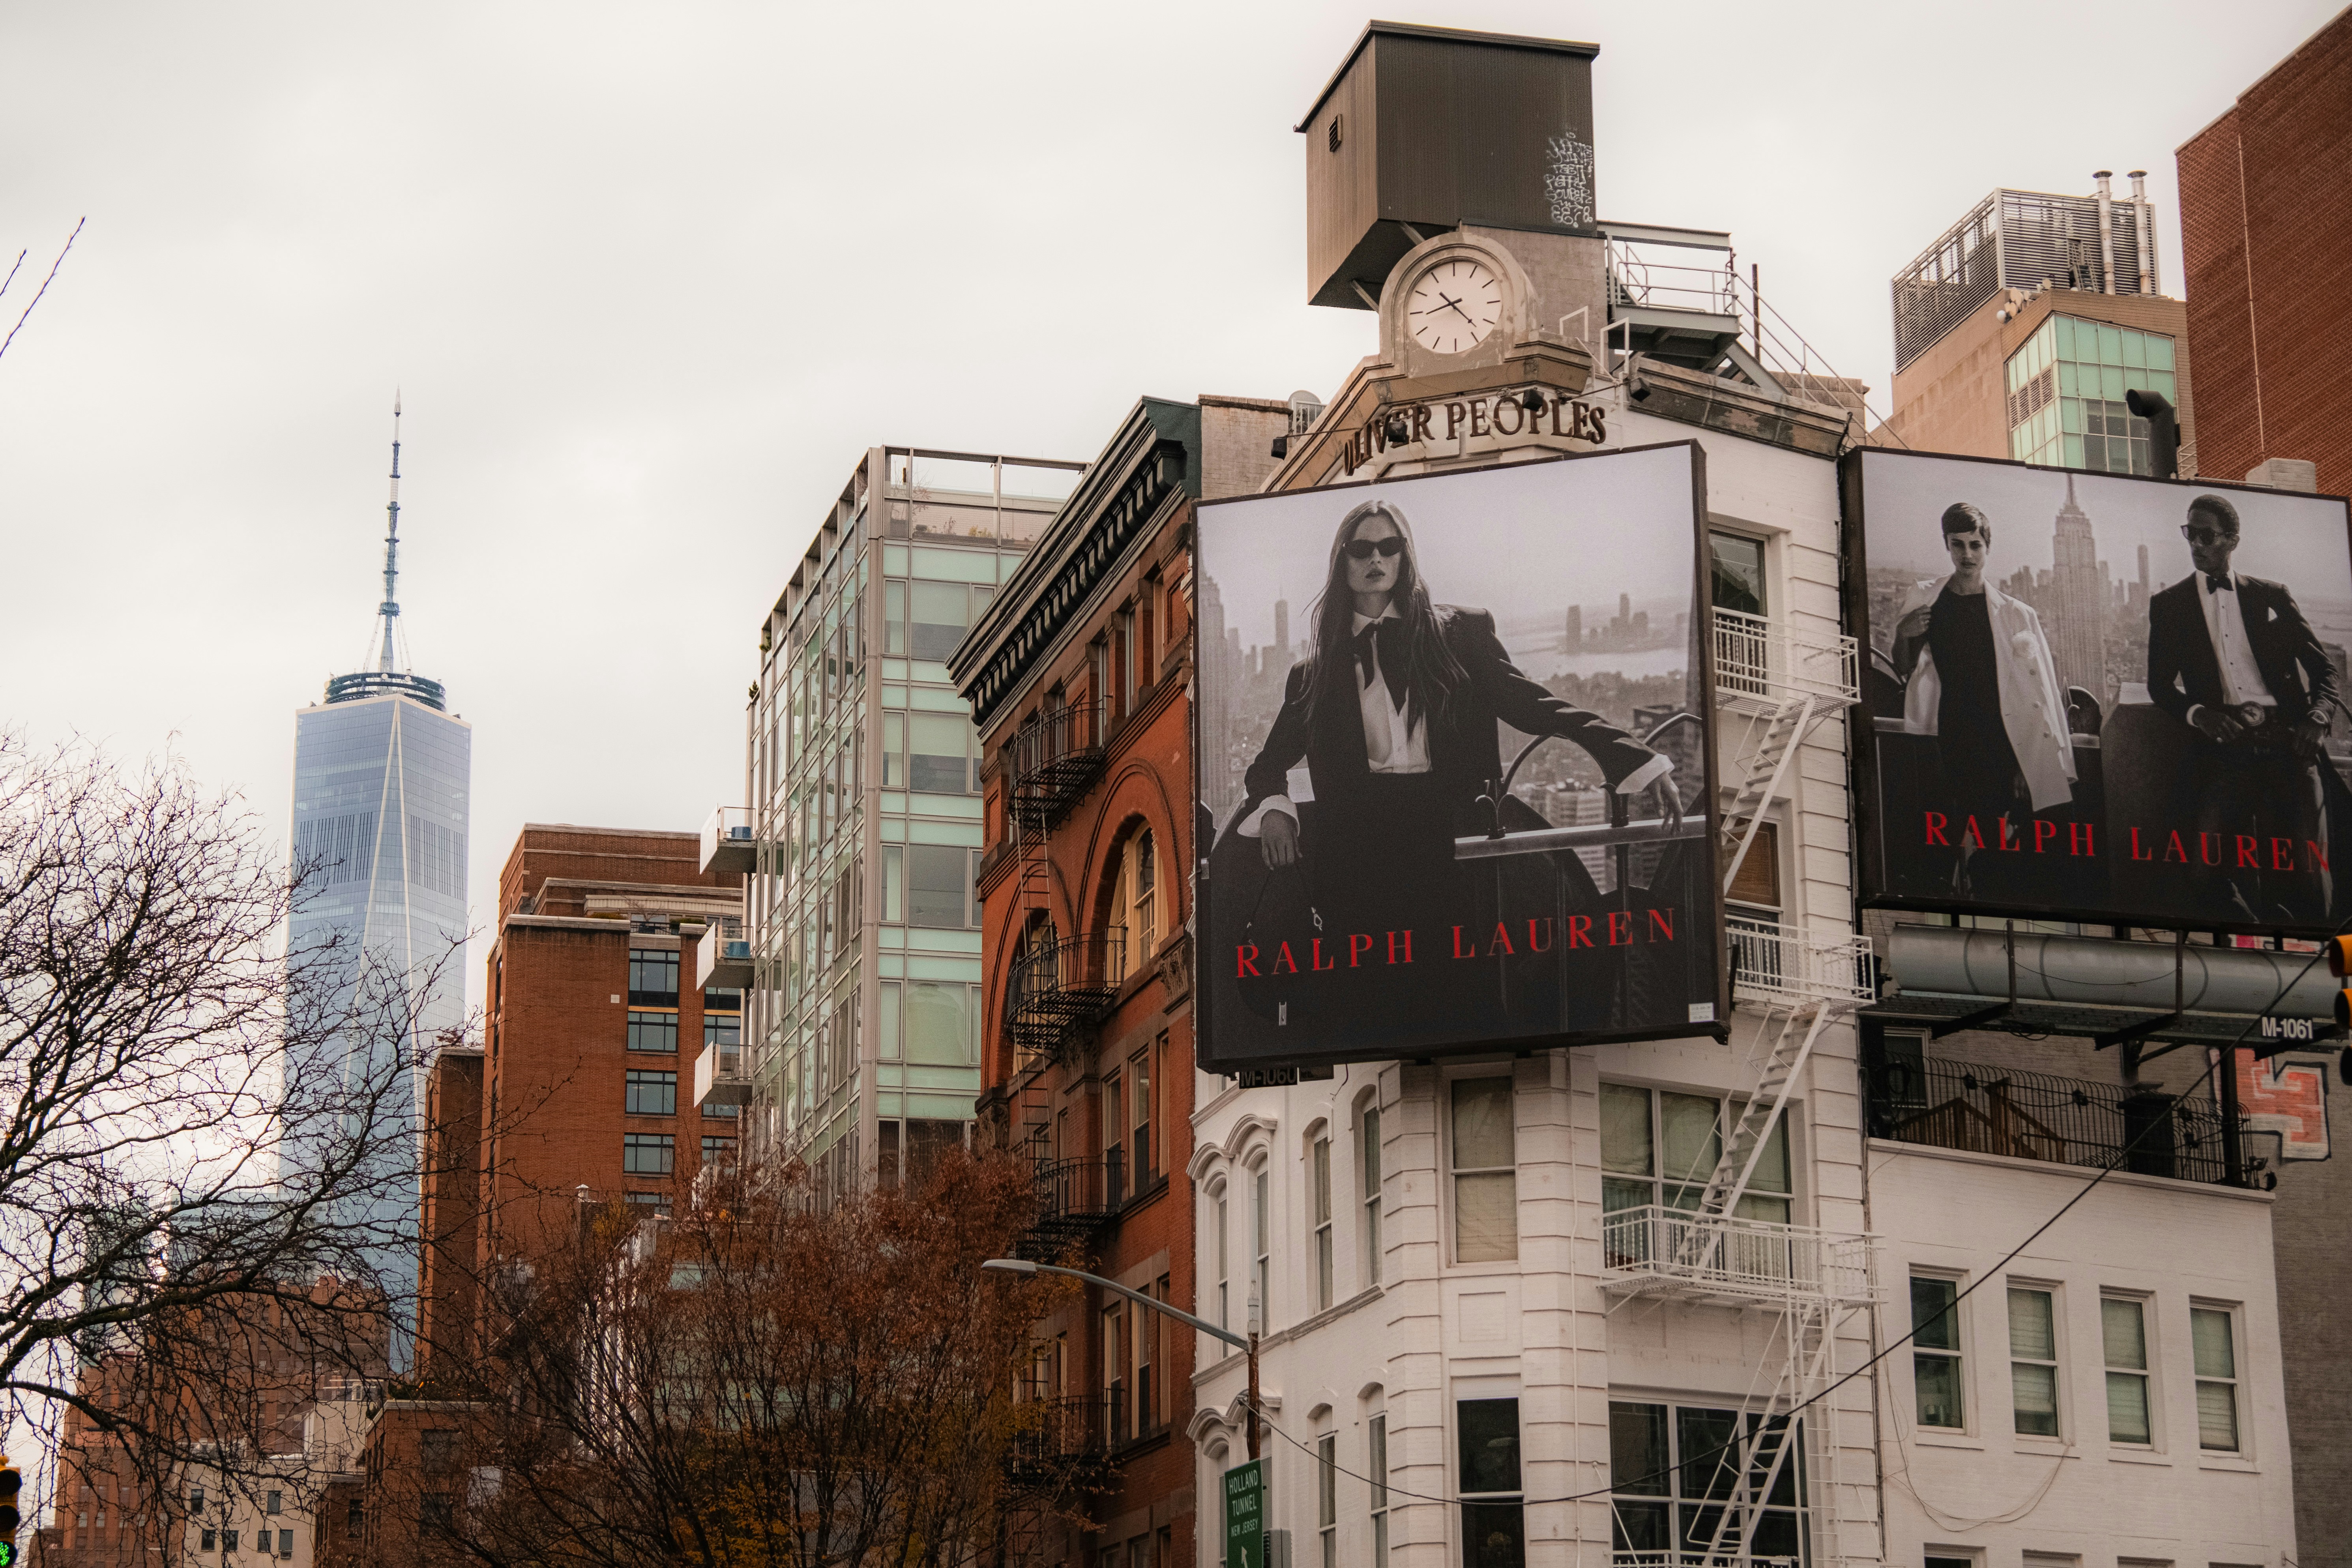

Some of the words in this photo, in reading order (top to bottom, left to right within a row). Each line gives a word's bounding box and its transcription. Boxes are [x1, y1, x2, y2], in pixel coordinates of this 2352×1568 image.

[1444, 397, 1605, 444] PEOPLES
[1924, 812, 2095, 856] RALPH
[2131, 827, 2330, 872] LAUREN
[1236, 930, 1413, 978] RALPH
[1451, 908, 1675, 958] LAUREN
[2262, 1017, 2313, 1039] M-1061
[1229, 1470, 1258, 1495] HOLLAND
[1232, 1494, 1257, 1517] TUNNEL
[1231, 1524, 1240, 1537] NEW
[1242, 1519, 1258, 1533] JERSEY
